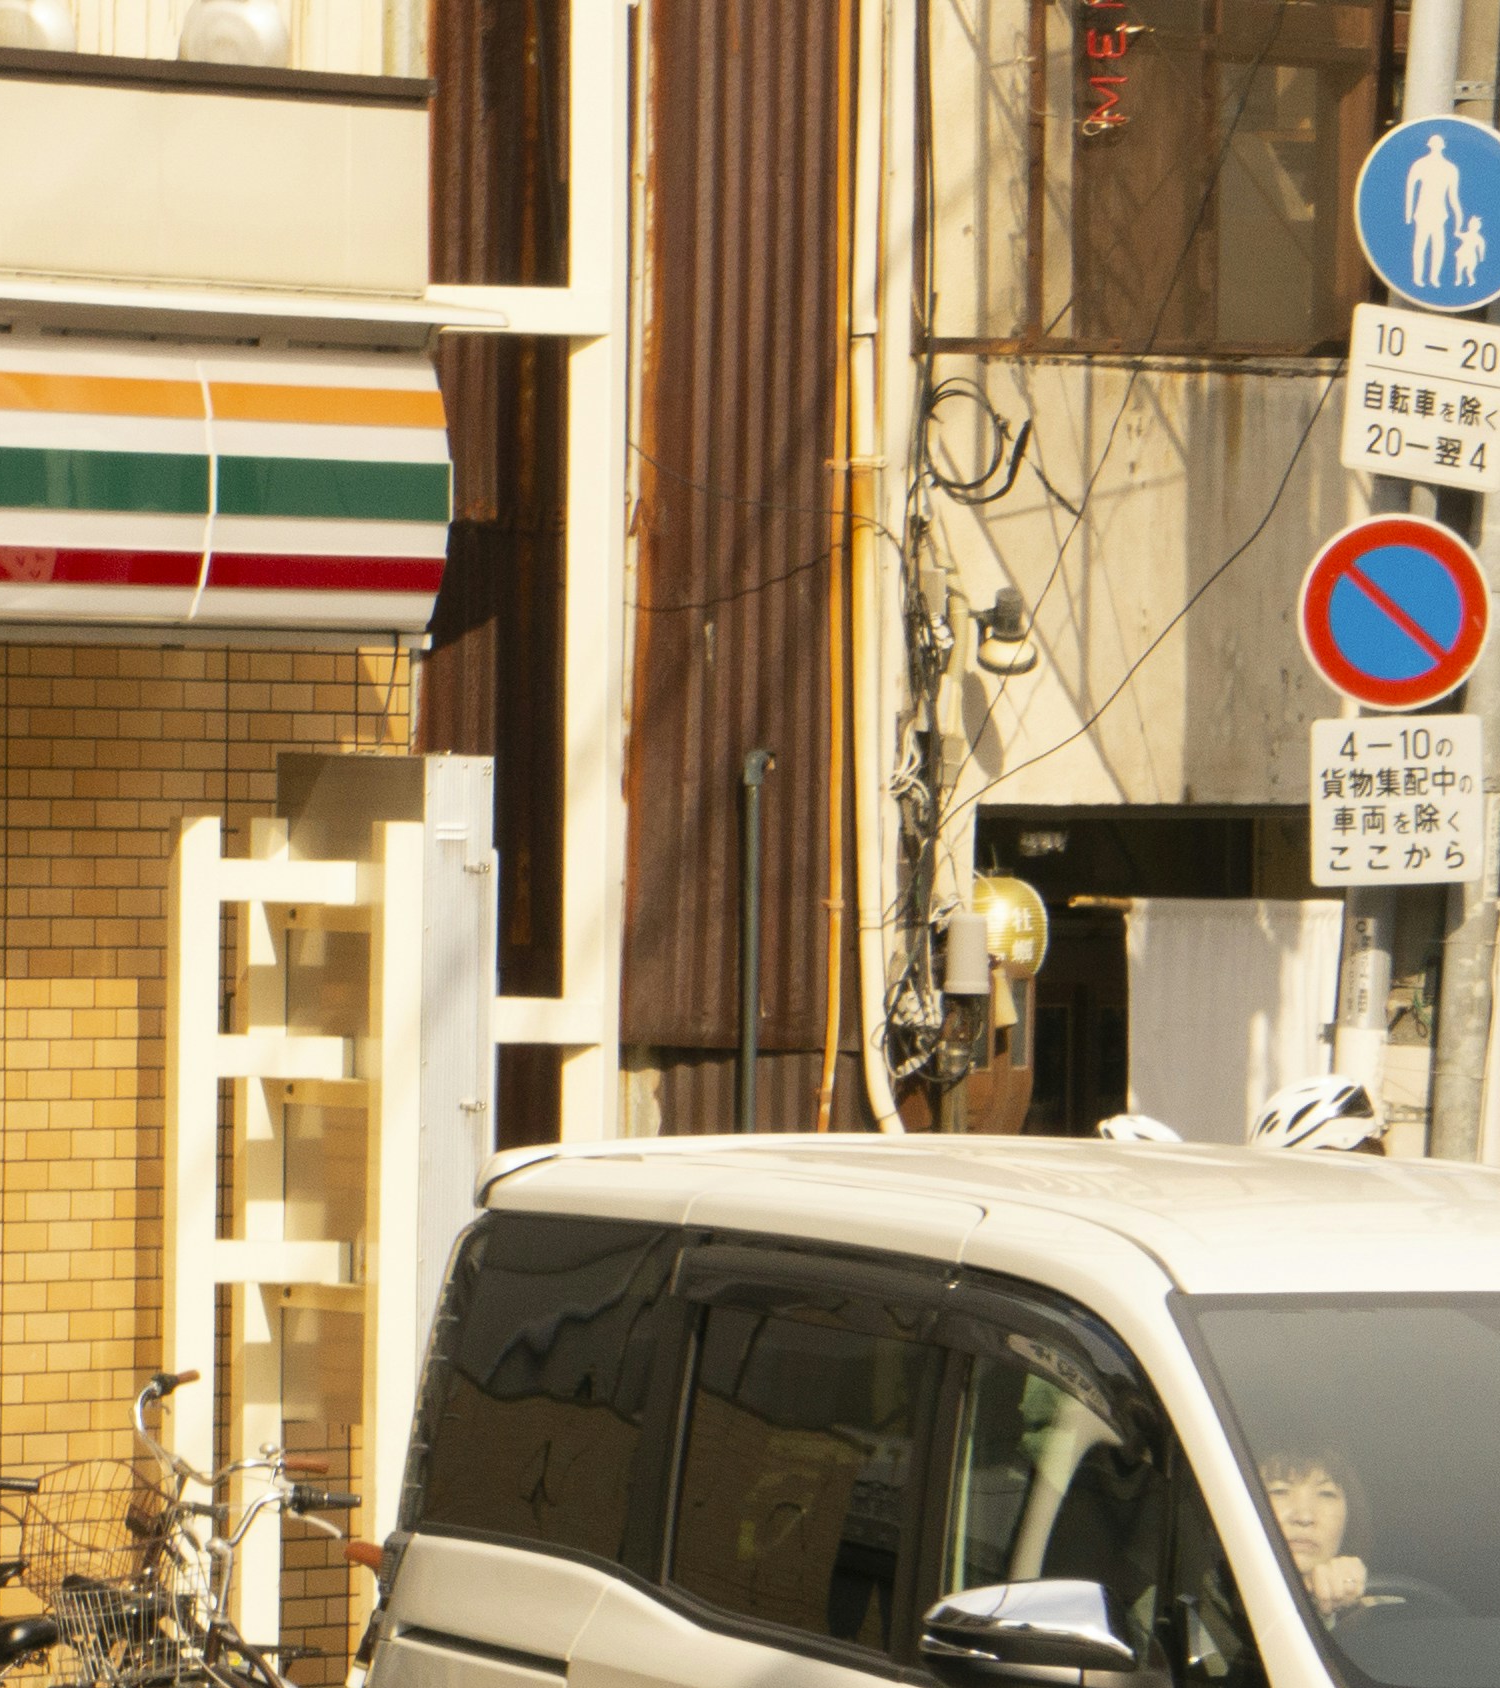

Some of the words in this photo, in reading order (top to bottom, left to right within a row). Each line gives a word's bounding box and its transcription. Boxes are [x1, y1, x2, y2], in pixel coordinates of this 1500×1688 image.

[1363, 380, 1499, 431] 自転車を除く
[1320, 767, 1473, 799] 貨物集配中の
[1331, 803, 1461, 836] 車両を除く
[1328, 842, 1466, 871] ここから
